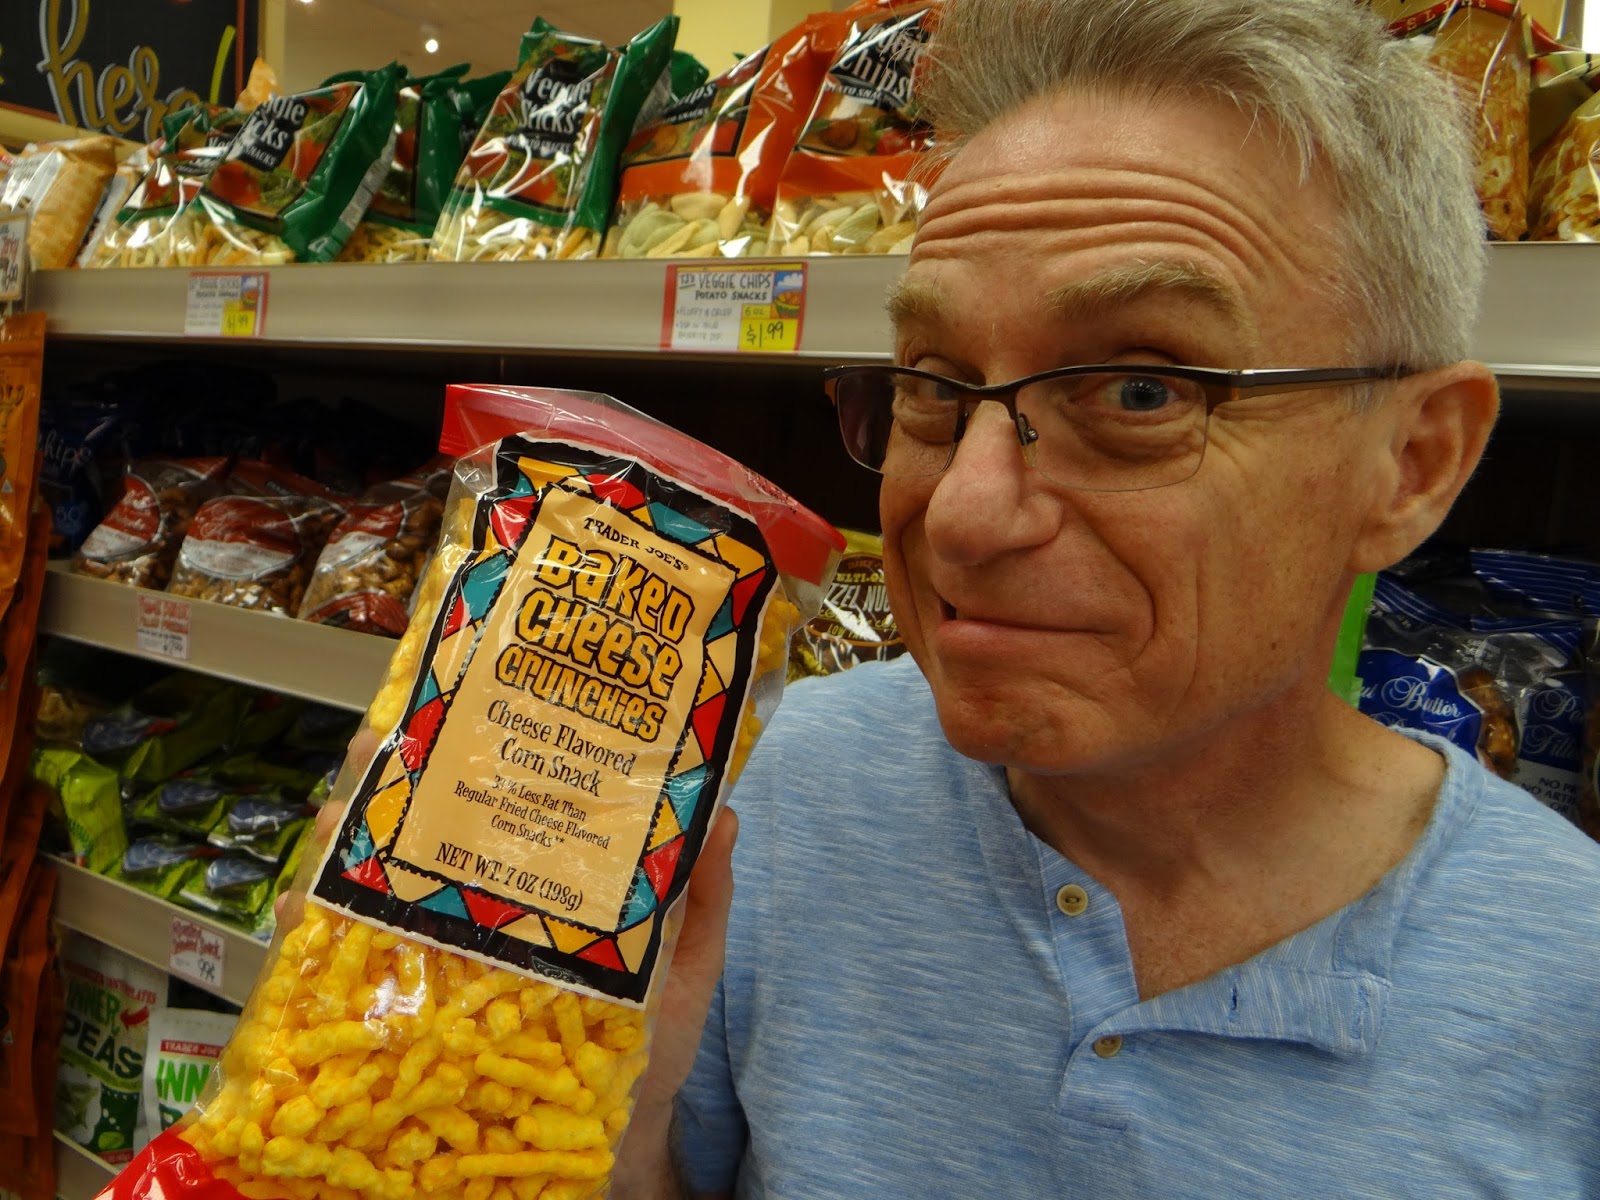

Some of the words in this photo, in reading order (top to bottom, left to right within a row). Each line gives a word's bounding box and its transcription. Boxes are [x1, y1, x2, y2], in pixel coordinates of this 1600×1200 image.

[695, 291, 728, 300] POTATO
[732, 292, 767, 300] SNACKS
[699, 274, 737, 289] VEGGIE
[740, 274, 771, 289] CHIPS
[583, 517, 640, 550] TRADER
[1381, 675, 1461, 717] Butter
[487, 699, 552, 742] Cheese
[553, 723, 637, 777] Flavored
[500, 737, 545, 771] Corn
[546, 755, 604, 797] Snack
[453, 780, 498, 811] Regular
[498, 796, 528, 820] Fried
[528, 806, 564, 833] Cheese
[564, 821, 611, 850] Flavored
[518, 784, 542, 805] Less
[541, 792, 560, 812] Fat
[561, 799, 587, 822] Than
[491, 814, 516, 833] Corn
[434, 841, 472, 872] NET
[474, 858, 504, 882] WT.
[503, 866, 517, 887] 7
[516, 870, 540, 894] OZ
[540, 877, 584, 912] (198g)
